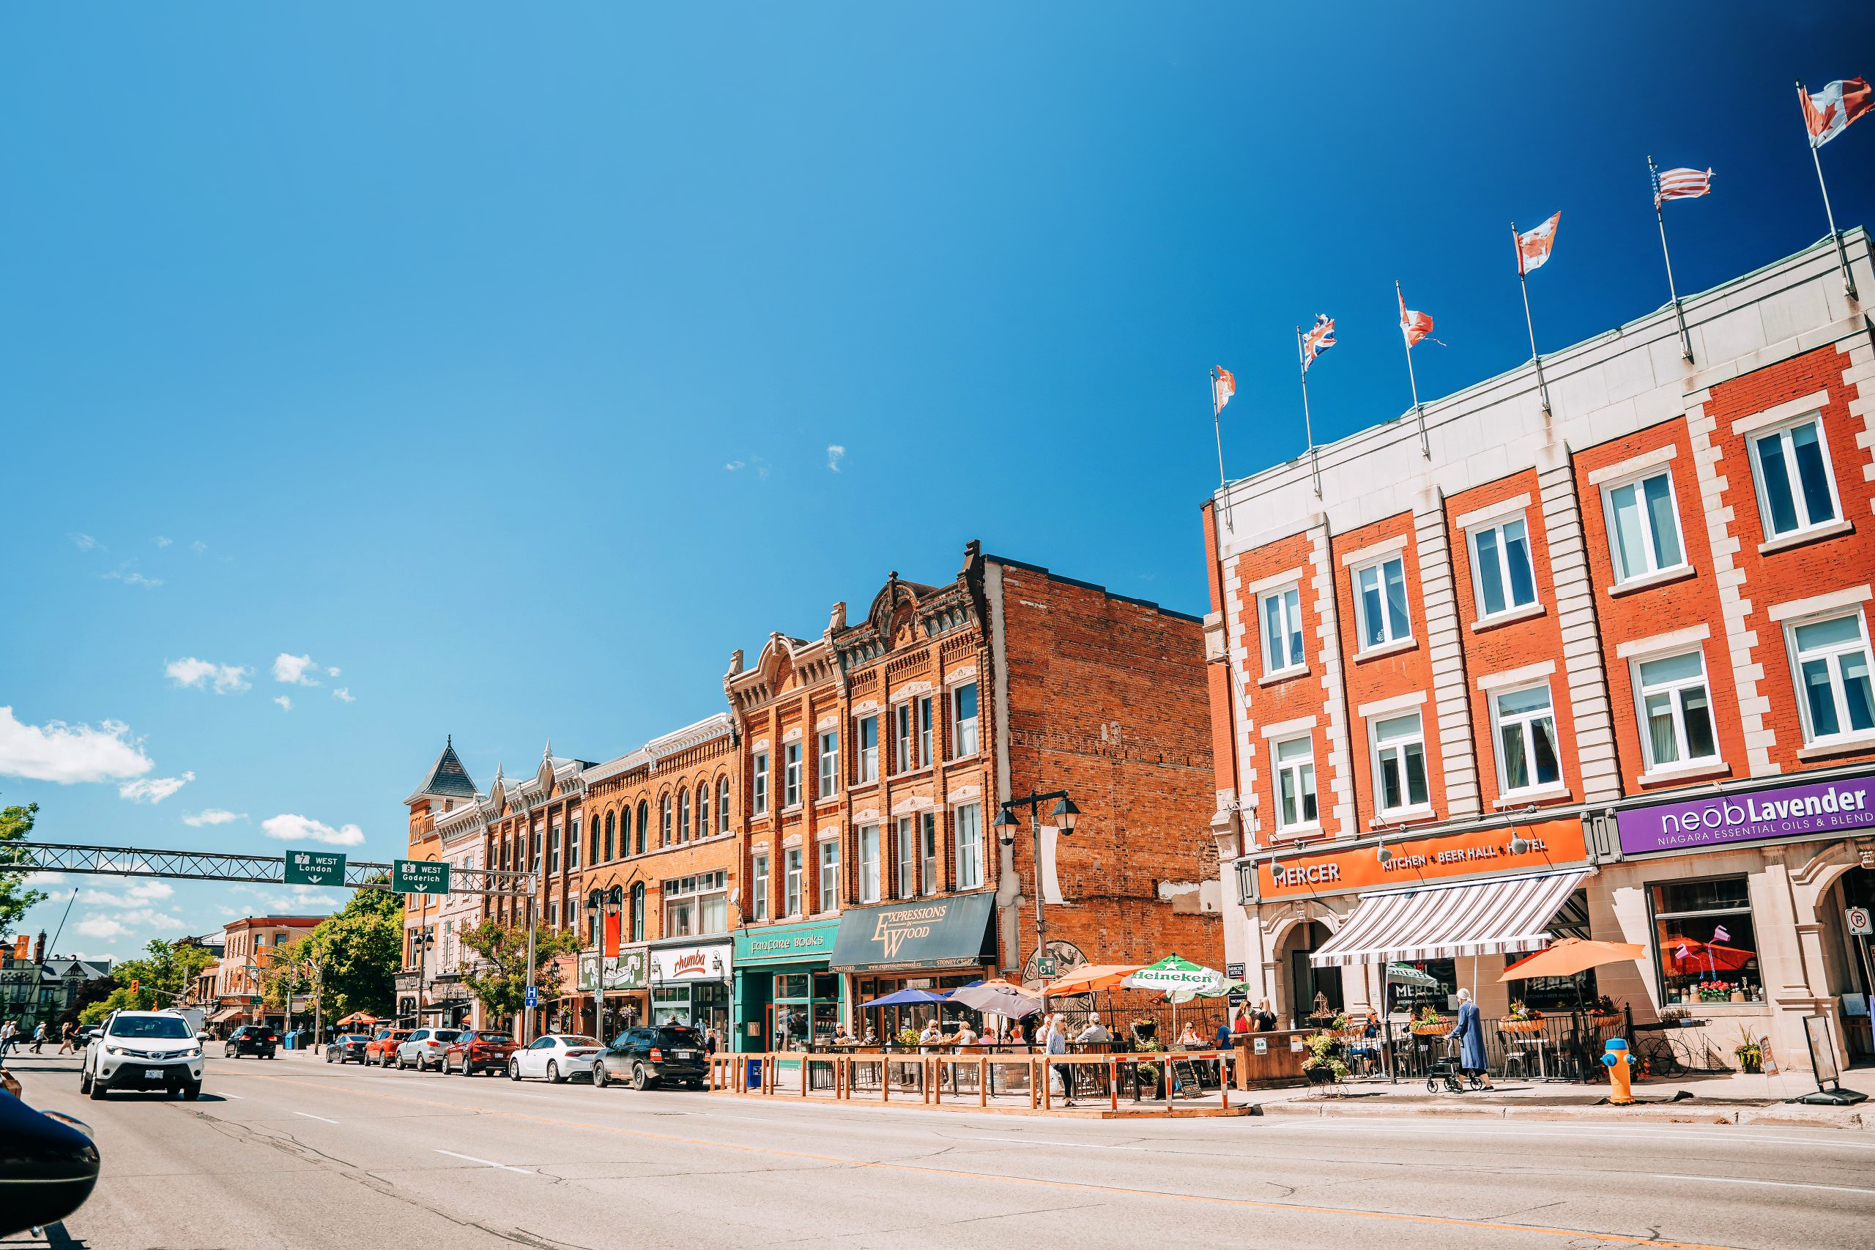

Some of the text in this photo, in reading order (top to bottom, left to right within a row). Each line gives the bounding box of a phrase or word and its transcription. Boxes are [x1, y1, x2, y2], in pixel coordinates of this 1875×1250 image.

[1747, 786, 1866, 824] Lavender
[1657, 832, 1709, 846] NIAGARA
[1714, 823, 1777, 839] ESSENTIAL
[1781, 819, 1810, 831] OILS
[1816, 817, 1825, 827] &
[300, 855, 338, 865] 7 WEST
[1273, 862, 1341, 887] MERCER
[1437, 848, 1466, 863] BEER
[1467, 844, 1496, 859] HALL
[1506, 838, 1547, 853] HTEL
[299, 864, 332, 873] London
[421, 866, 442, 874] WEST
[402, 874, 440, 882] Goderich
[871, 905, 947, 941] EXPRESSIONS
[883, 926, 930, 958] WOOD
[674, 949, 706, 973] rhumba
[1132, 971, 1213, 983] Heineken
[527, 987, 536, 998] H
[1395, 983, 1449, 998] MERCER
